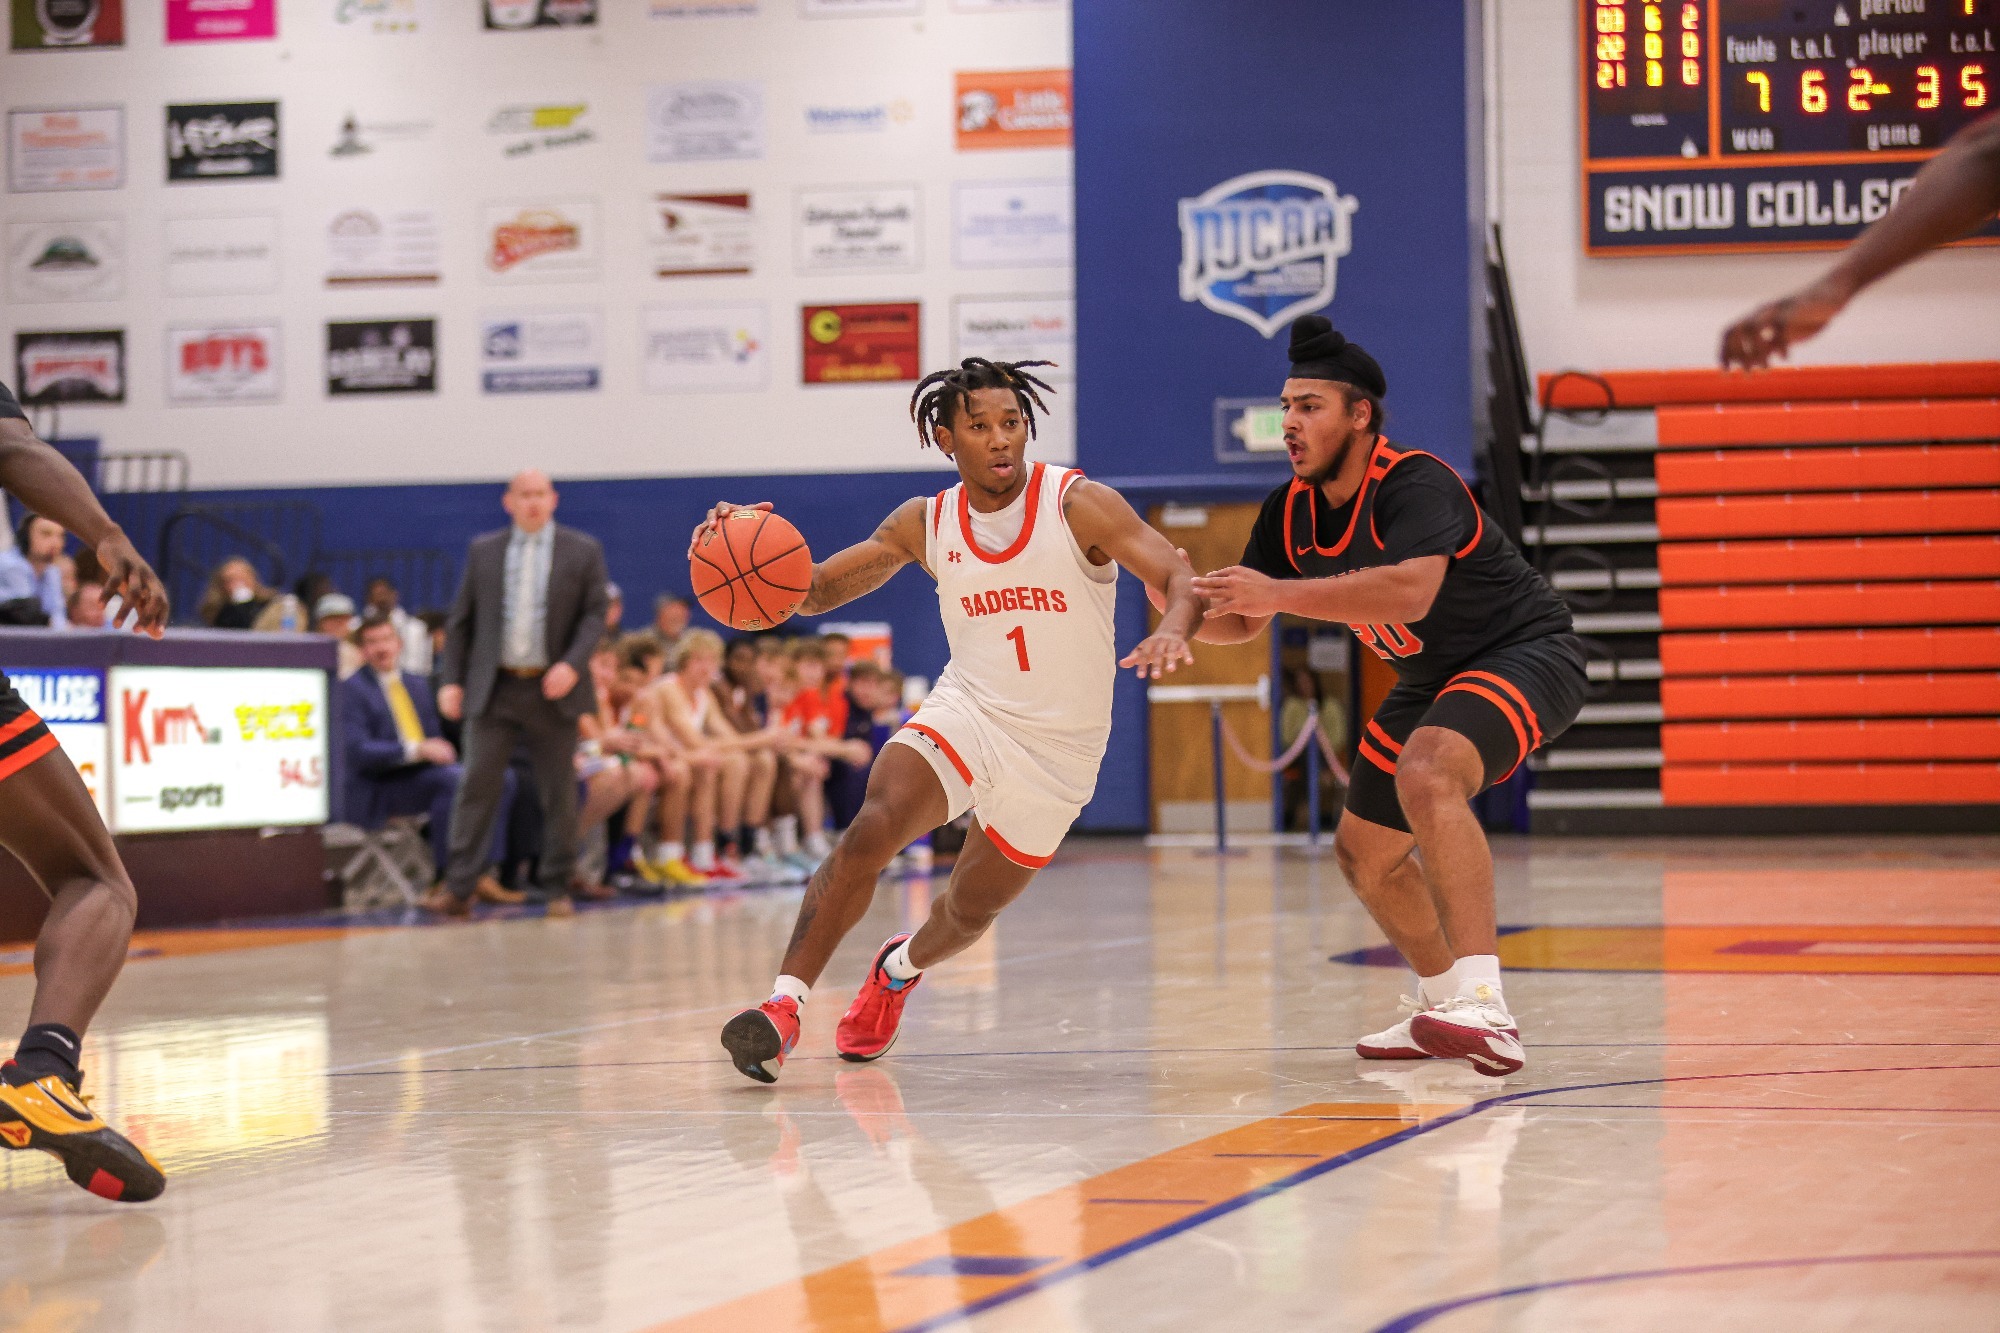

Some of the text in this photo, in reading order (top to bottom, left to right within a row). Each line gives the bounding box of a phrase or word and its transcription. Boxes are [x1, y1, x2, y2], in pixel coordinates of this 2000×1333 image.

[1859, 29, 1928, 60] player
[1746, 71, 1771, 113] 7
[1801, 68, 1828, 113] 6
[1916, 65, 1941, 109] 3
[1961, 64, 1988, 108] 5
[1732, 124, 1922, 151] won game
[1604, 177, 1918, 233] SNOW COLLE
[960, 587, 1068, 617] BADGERS
[1006, 626, 1030, 671] 1
[10, 674, 99, 721] OLLEGE
